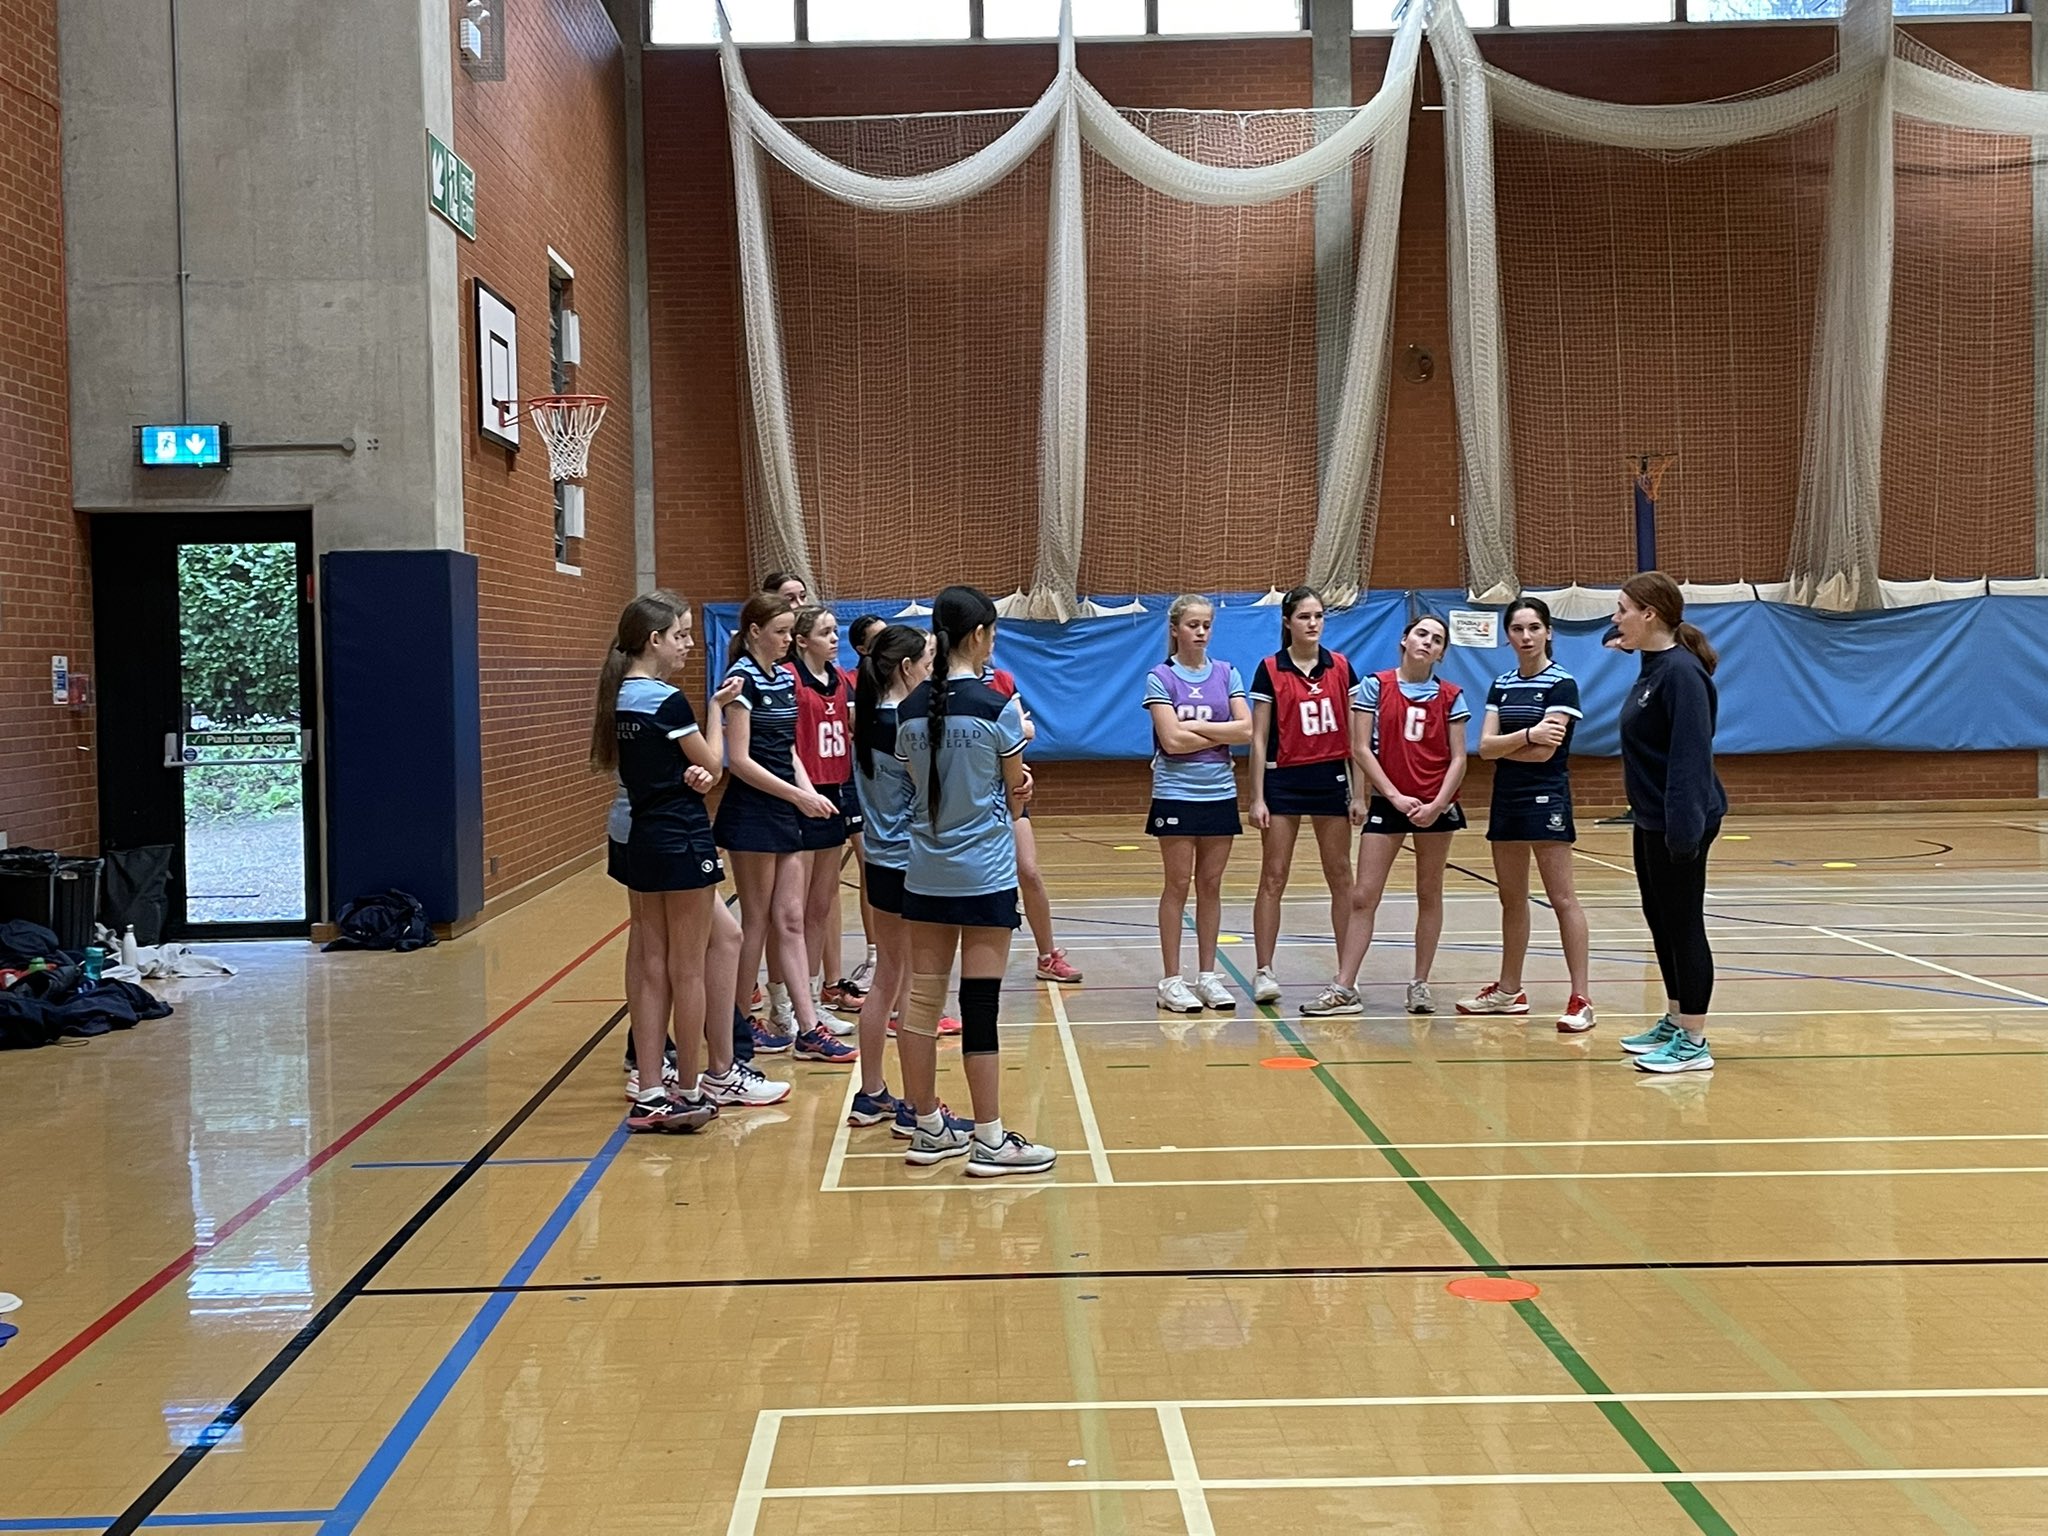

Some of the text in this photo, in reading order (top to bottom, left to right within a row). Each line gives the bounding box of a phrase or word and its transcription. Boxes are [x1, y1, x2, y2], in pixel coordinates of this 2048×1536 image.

[1299, 697, 1339, 736] GA
[206, 734, 291, 744] Push bar to open
[818, 720, 846, 758] GS
[905, 729, 982, 742] BRAIELD
[911, 739, 973, 751] COEGE
